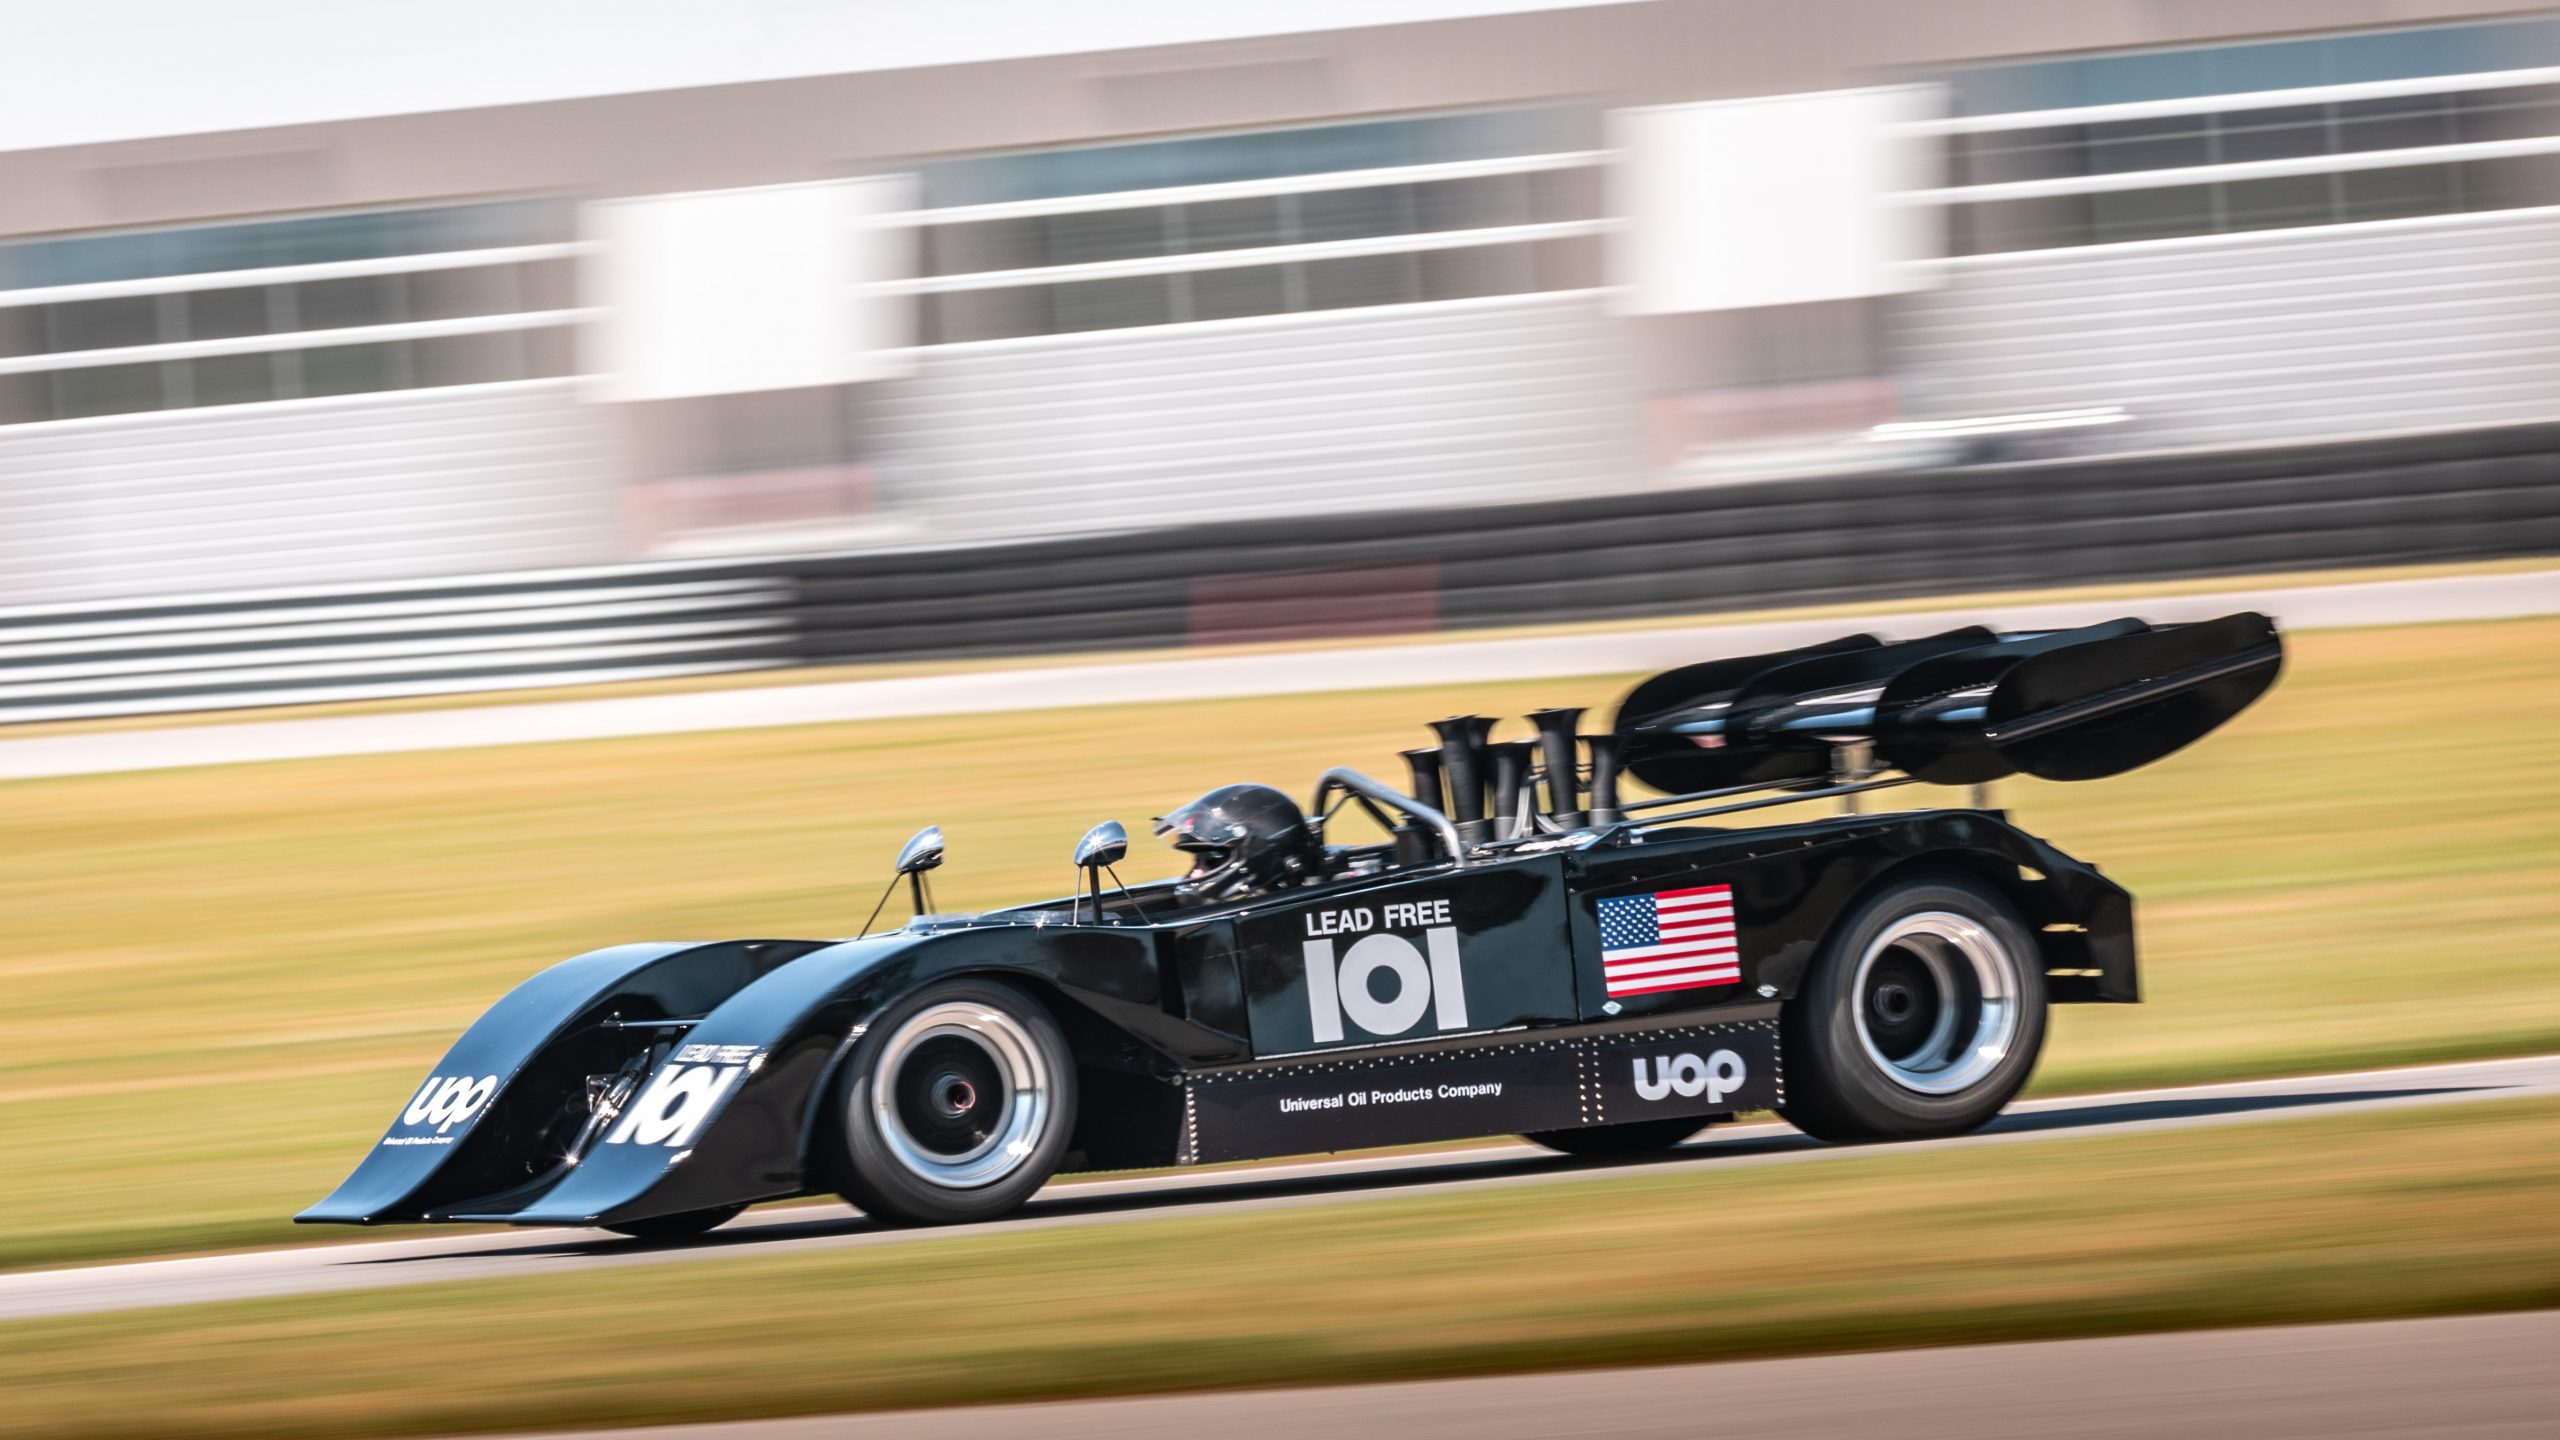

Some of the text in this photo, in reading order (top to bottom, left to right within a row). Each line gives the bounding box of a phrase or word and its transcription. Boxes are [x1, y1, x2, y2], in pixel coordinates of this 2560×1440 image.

[1305, 899, 1452, 936] LEAD FREE
[1302, 925, 1469, 1043] 101
[605, 1064, 746, 1147] 101
[1280, 1082, 1502, 1112] Universal Oil Products Company
